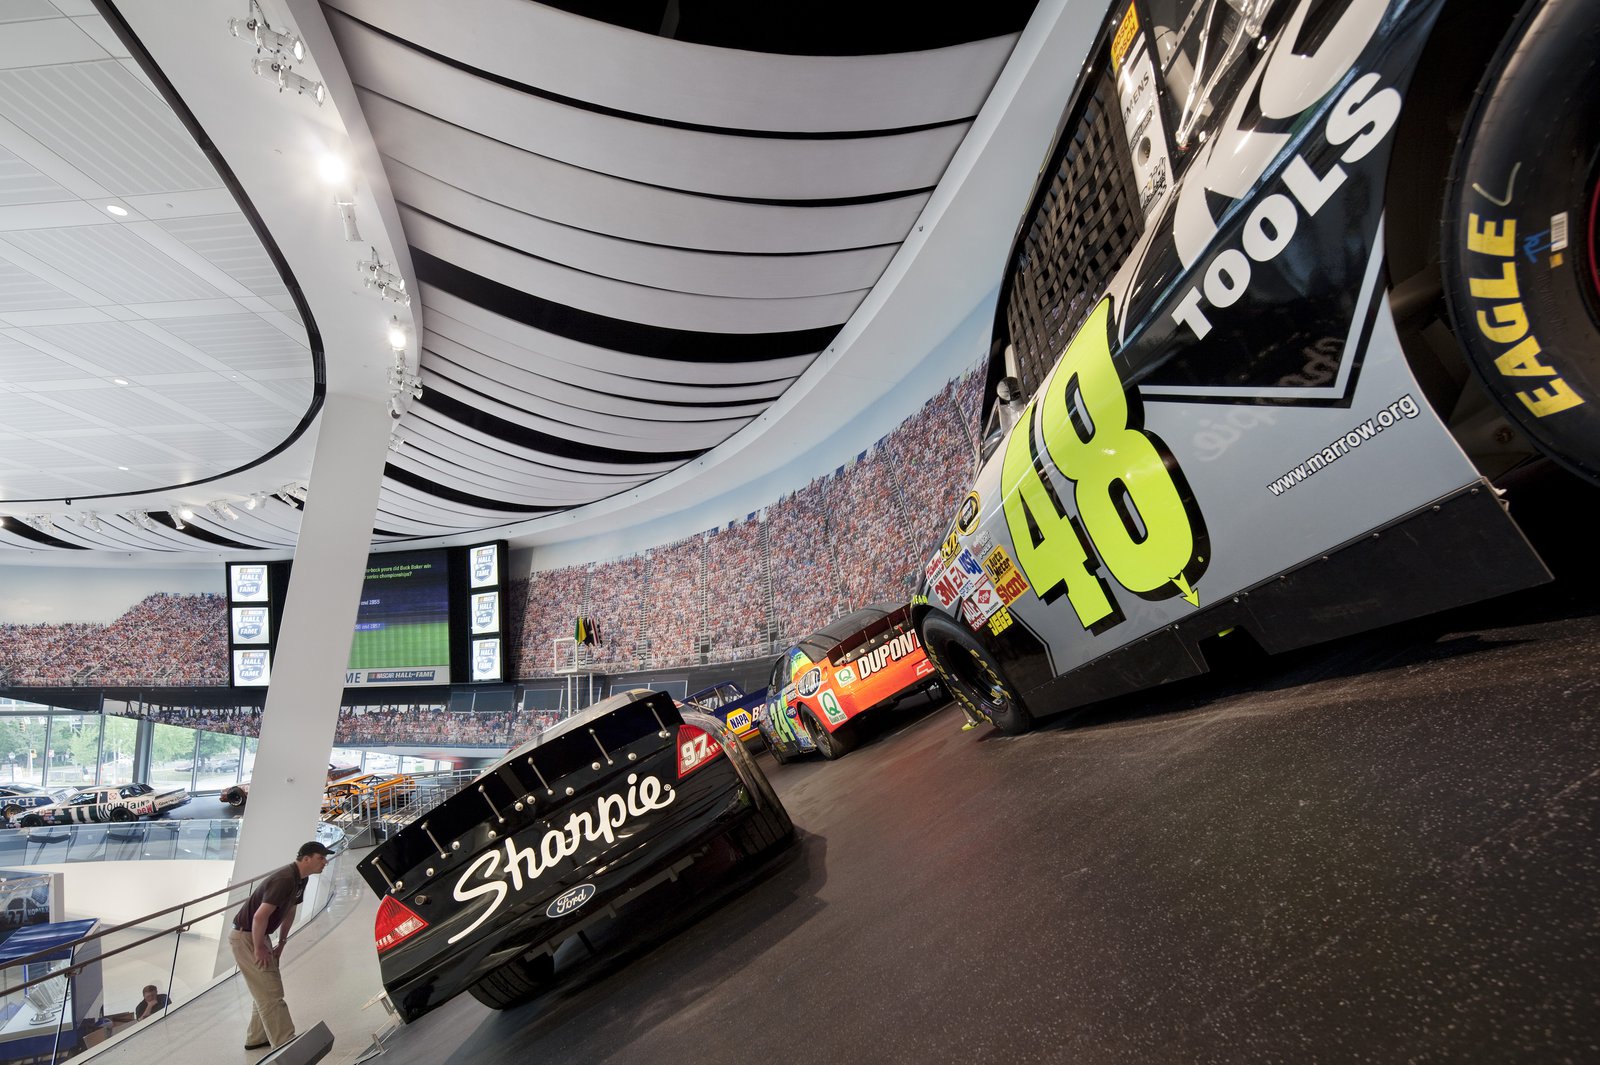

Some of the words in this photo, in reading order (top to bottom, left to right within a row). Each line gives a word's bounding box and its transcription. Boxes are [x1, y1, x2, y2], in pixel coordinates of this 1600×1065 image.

[1113, 10, 1134, 53] BOSCH
[1115, 23, 1137, 66] BOSCH
[1171, 72, 1402, 341] TOOLS
[1467, 212, 1586, 418] EAGLE
[1267, 393, 1420, 497] www.marrow.org
[1000, 296, 1206, 632] 48
[988, 551, 1003, 568] Auto
[993, 557, 1012, 585] Meter
[935, 574, 959, 606] 3M
[949, 566, 969, 590] EA
[995, 569, 1028, 606] Stant
[971, 615, 987, 631] TOOLS
[988, 605, 1014, 637] JEGS
[857, 628, 921, 680] DUPONT
[416, 670, 434, 678] FAME
[729, 713, 750, 730] NAPA
[681, 732, 708, 767] 97
[448, 773, 676, 944] Sharpie
[557, 888, 587, 913] Ford
